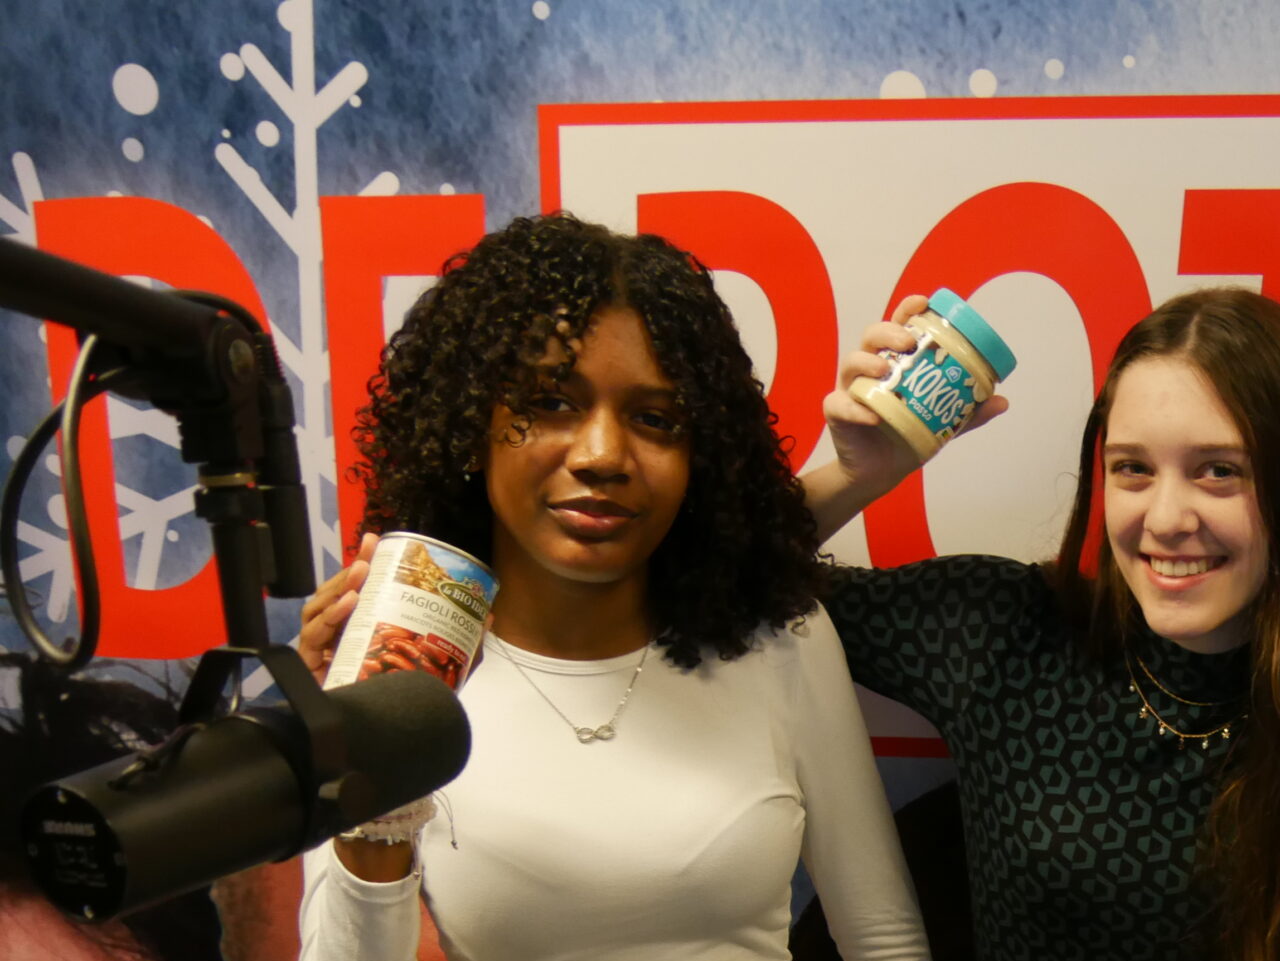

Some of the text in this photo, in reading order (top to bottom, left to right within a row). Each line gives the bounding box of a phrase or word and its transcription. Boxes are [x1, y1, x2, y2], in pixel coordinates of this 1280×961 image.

[902, 359, 964, 424] KOKOS
[401, 591, 479, 637] FAGIOLI ROSSI
[454, 589, 472, 605] BIO
